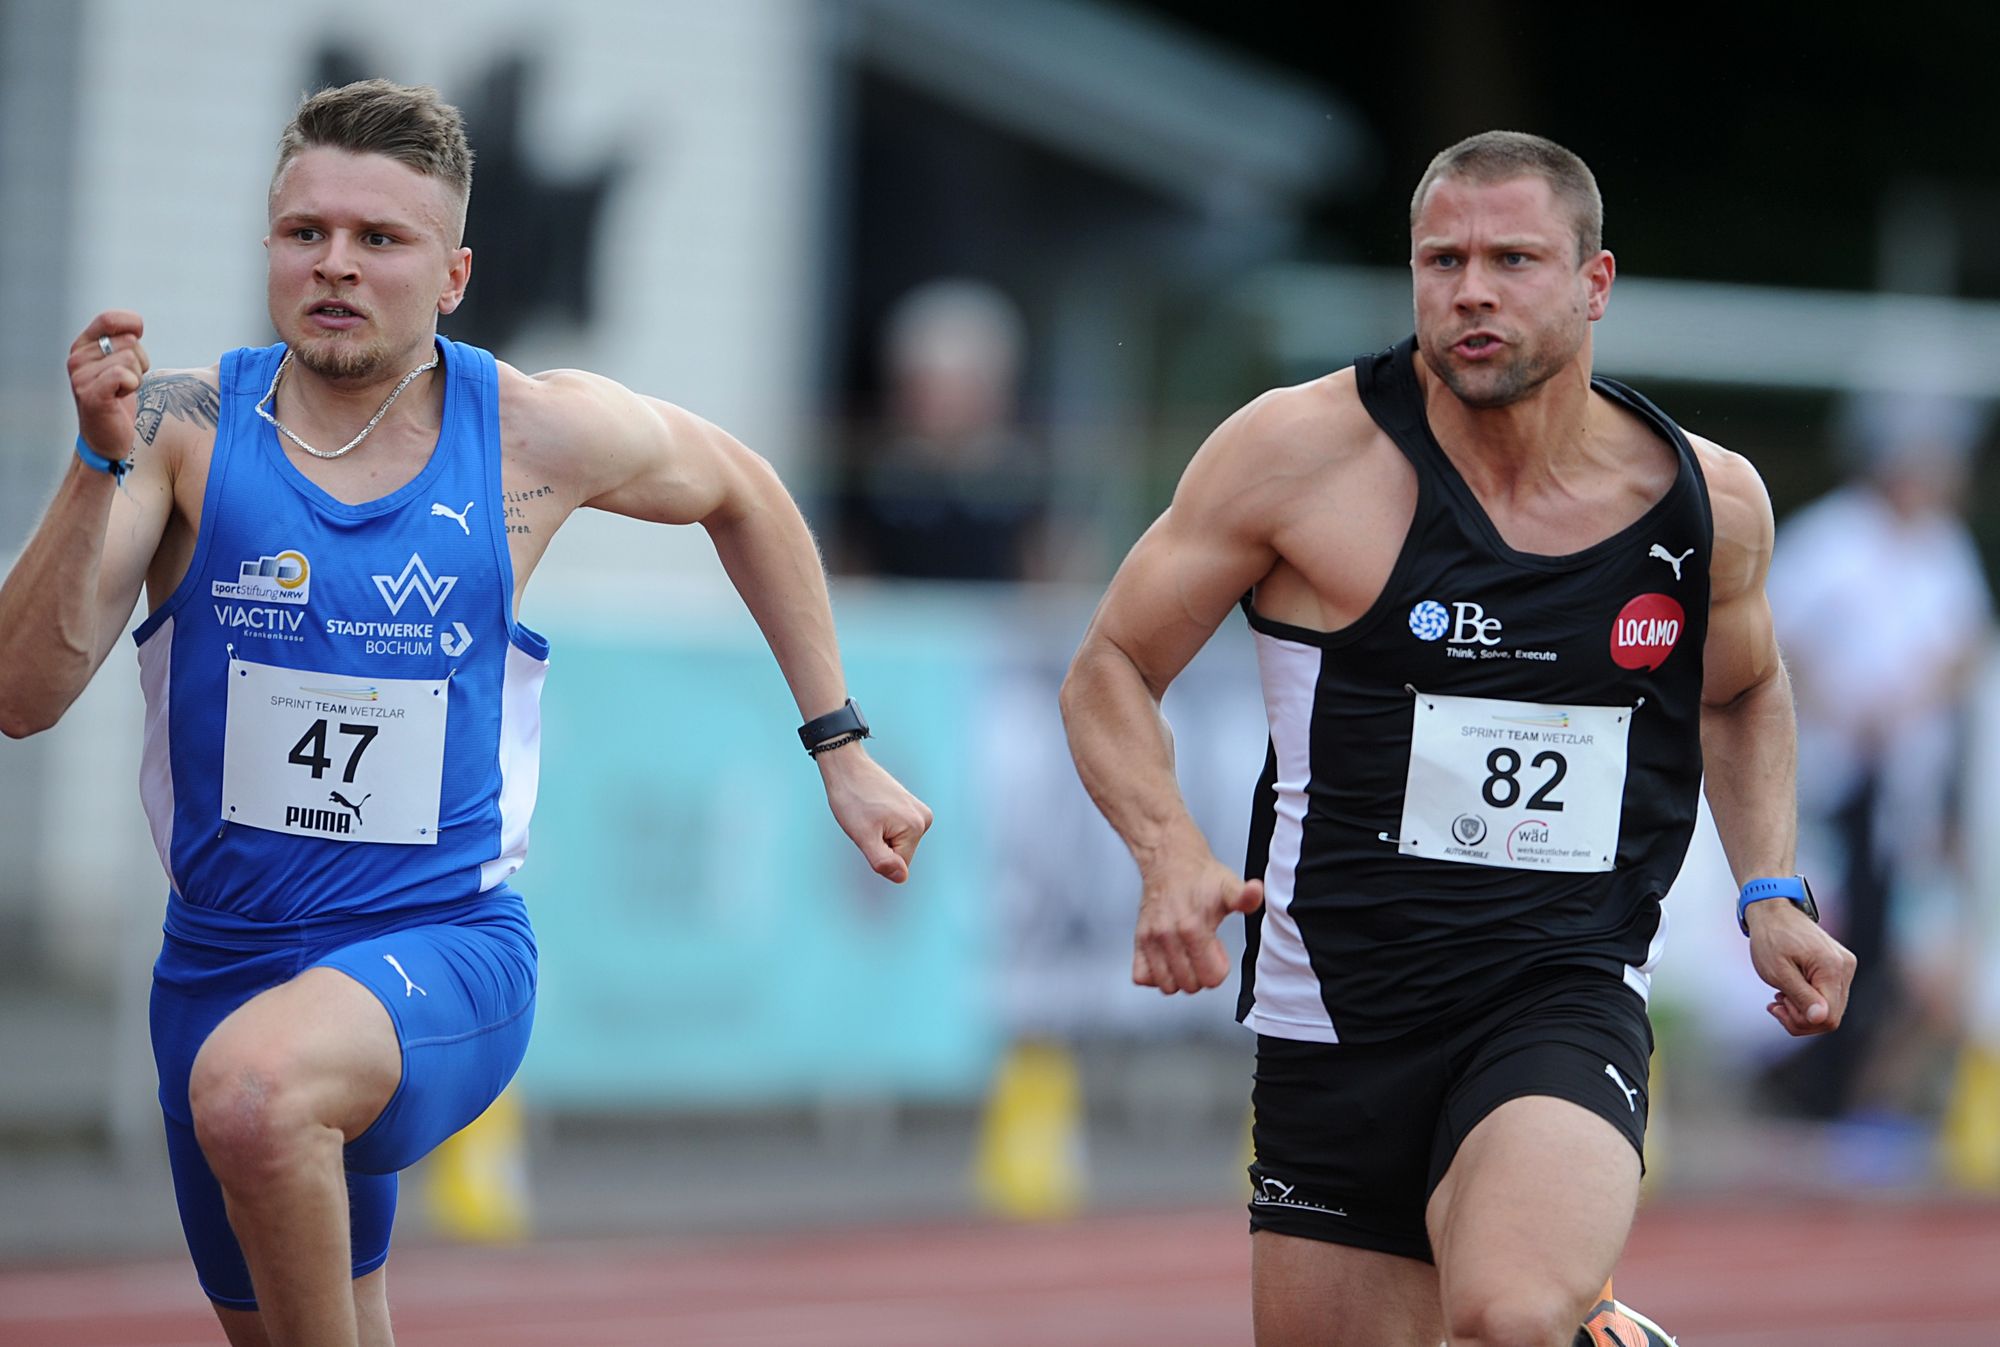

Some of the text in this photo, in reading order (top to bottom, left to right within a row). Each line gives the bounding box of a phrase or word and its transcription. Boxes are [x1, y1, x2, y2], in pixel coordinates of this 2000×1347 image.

[215, 584, 304, 600] sportStiftungNRW
[213, 604, 305, 632] VIACTIV
[1447, 601, 1503, 646] Be
[243, 630, 304, 642] Krankenkasse
[326, 619, 434, 638] STADTWERKE
[1618, 617, 1679, 647] LOCAMO
[366, 640, 433, 656] BOCHUM
[1446, 647, 1558, 661] Think, Solve, Execute
[270, 695, 405, 719] SPRINT TEAM WETZLAR
[1461, 726, 1594, 745] SPRINT TEAM WETZLAR
[288, 718, 379, 783] 47
[1481, 747, 1568, 812] 82
[285, 805, 351, 834] PUMA
[1518, 829, 1549, 843] wäd
[1444, 846, 1490, 859] AUTOMOBILE
